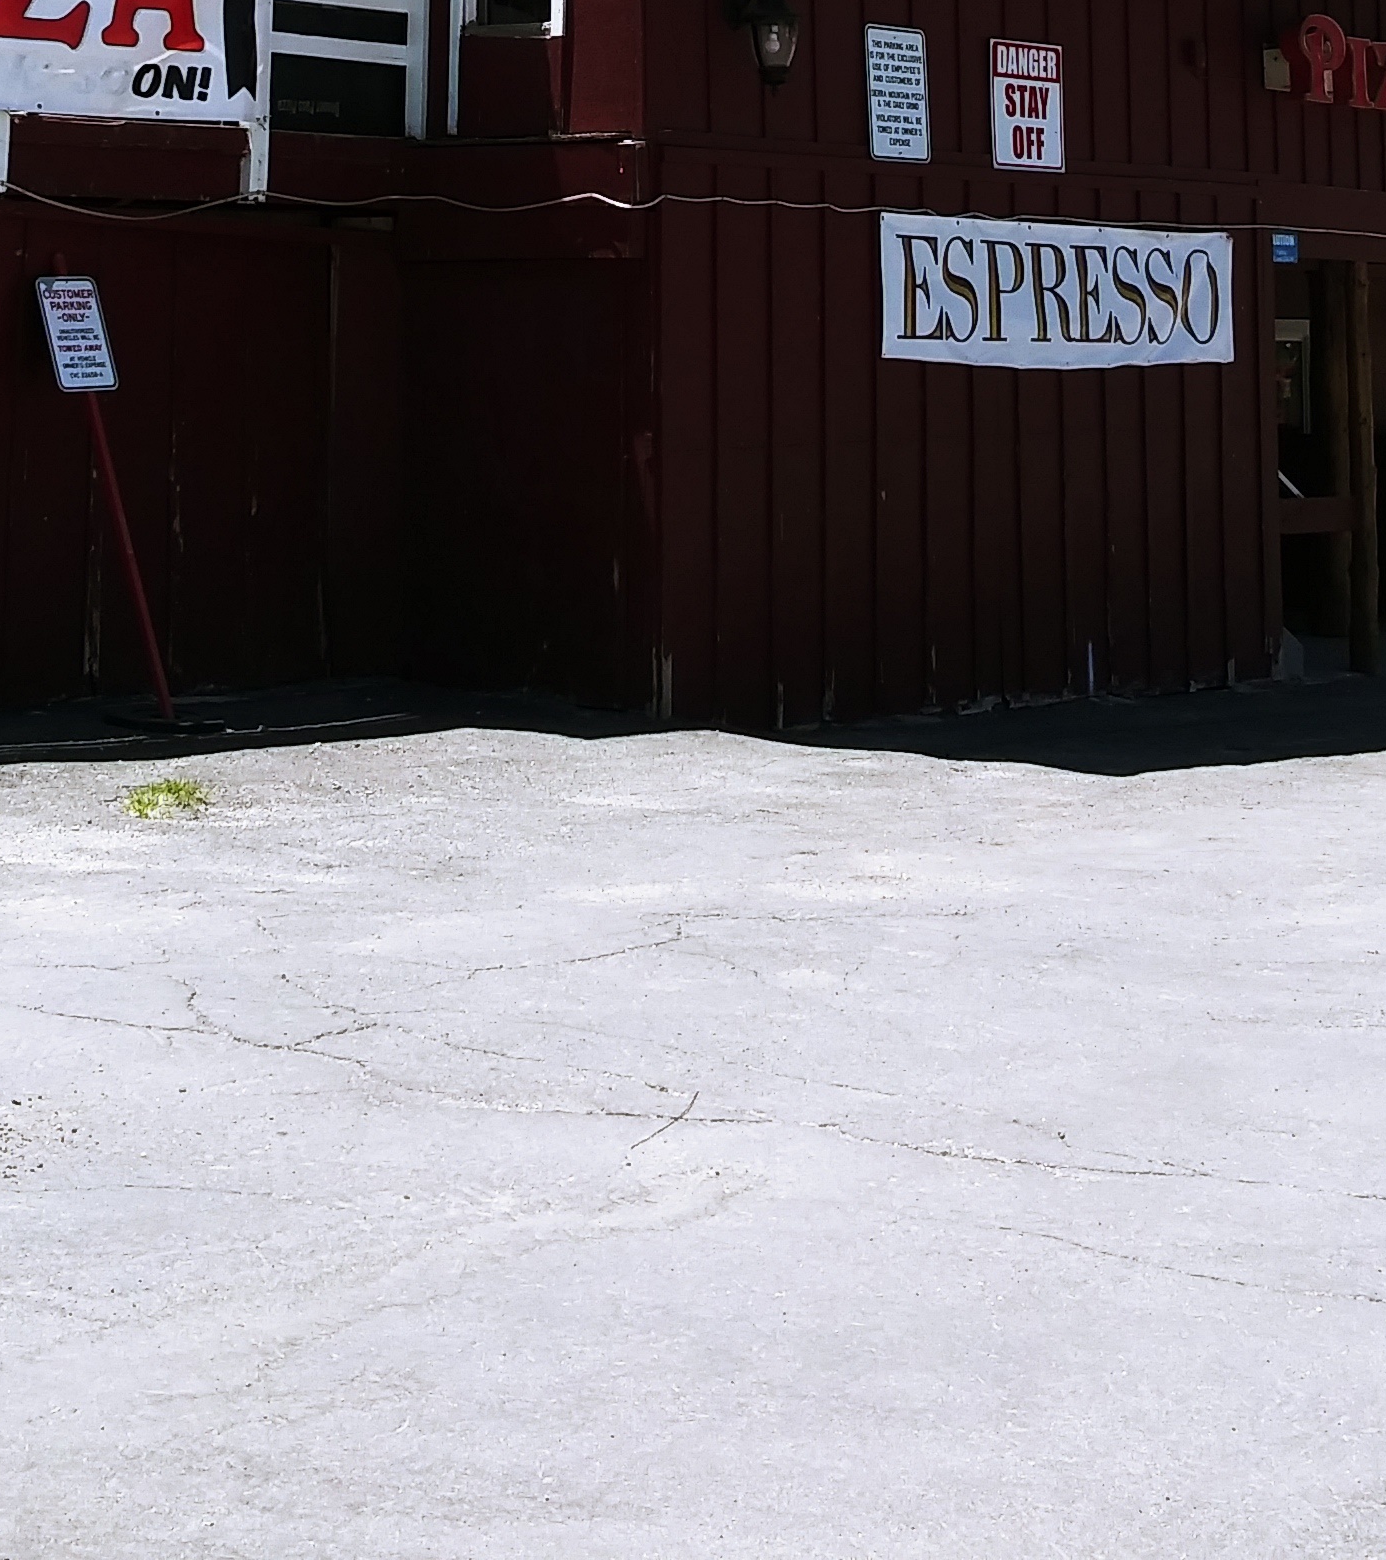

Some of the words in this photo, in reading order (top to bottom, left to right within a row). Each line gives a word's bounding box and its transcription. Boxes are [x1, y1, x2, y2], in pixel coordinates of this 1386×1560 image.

[872, 40, 882, 48] THIS
[884, 41, 903, 50] PARKING
[905, 44, 919, 52] AREA
[876, 52, 884, 60] FOR
[886, 53, 895, 61] THE
[897, 54, 922, 64] EXCLUSIVE
[997, 45, 1057, 80] DANGER
[872, 63, 881, 71] USE
[885, 76, 913, 85] CUSTOMERS
[915, 78, 921, 86] OF
[911, 93, 924, 101] PIZZA
[1005, 83, 1050, 120] STAY
[883, 100, 891, 108] THE
[893, 101, 904, 109] DAILY
[876, 114, 901, 123] VIOLATORS
[903, 116, 914, 124] WILL
[915, 117, 922, 125] BE
[876, 126, 892, 134] TOWED
[889, 138, 911, 147] EXPENSE
[1013, 125, 1045, 160] OFF
[43, 289, 94, 299] CUSTOMER
[895, 233, 1219, 345] ESPRESSO
[50, 301, 93, 311] PARKING
[57, 344, 83, 352] TOWED
